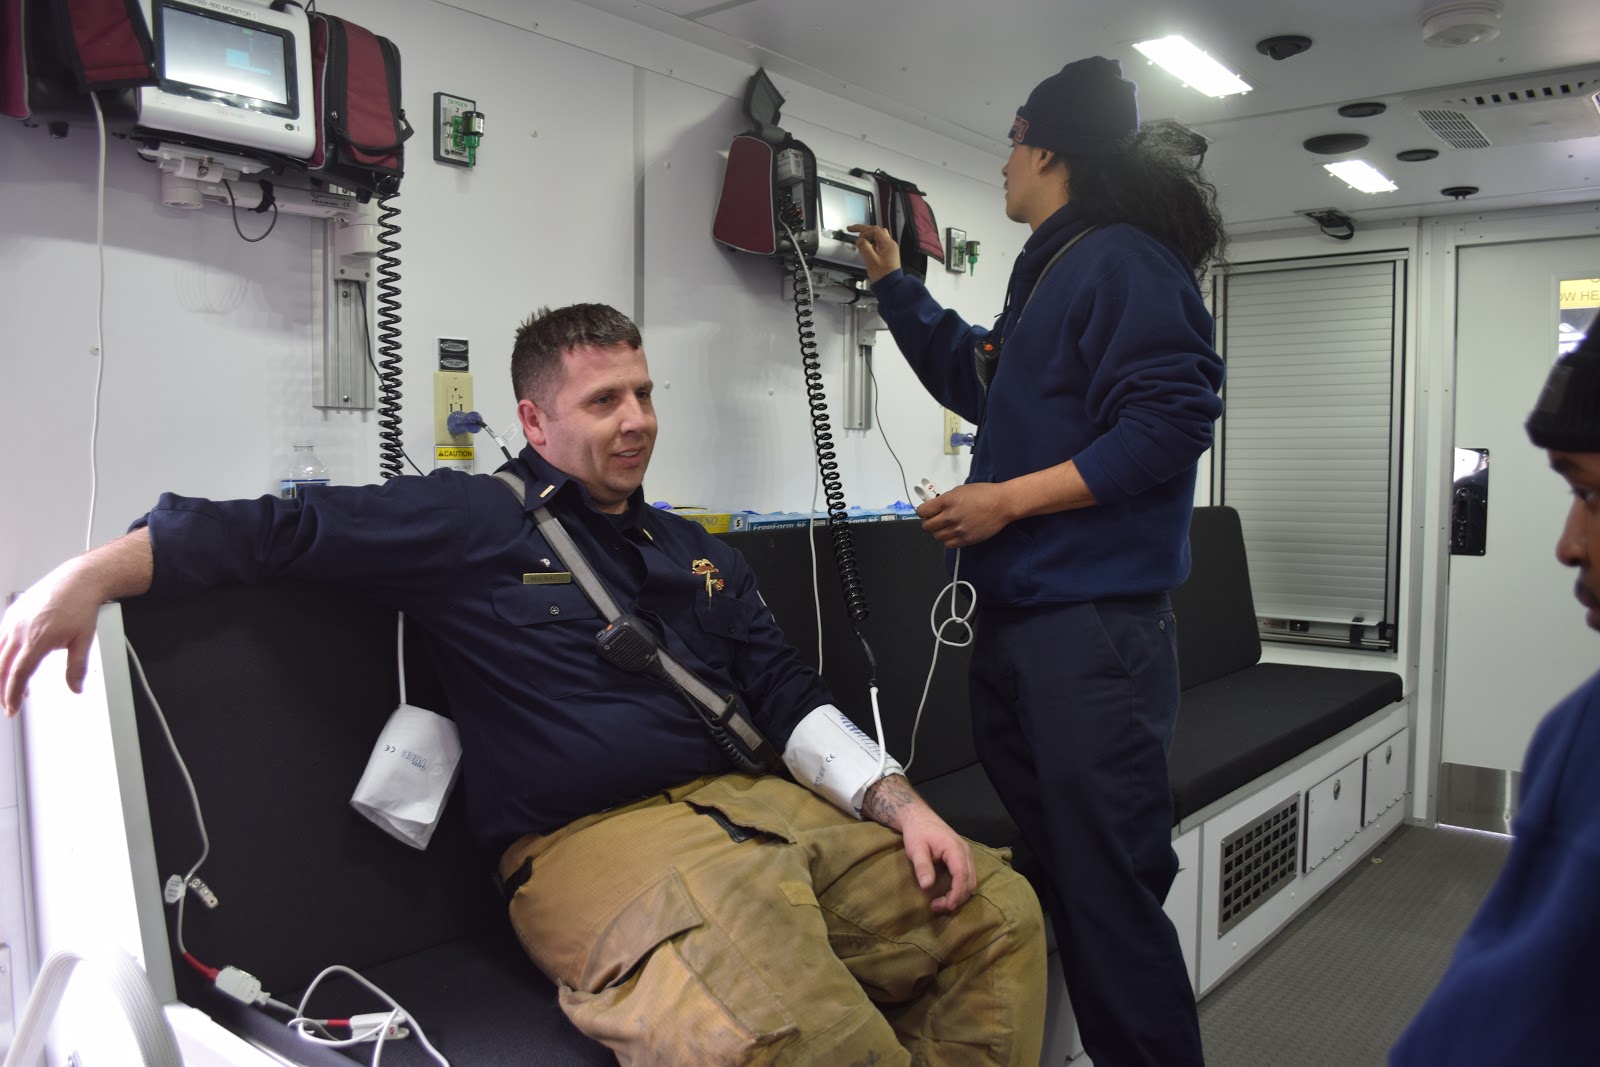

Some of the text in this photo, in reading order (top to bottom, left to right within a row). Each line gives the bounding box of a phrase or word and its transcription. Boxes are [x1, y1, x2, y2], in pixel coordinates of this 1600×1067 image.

[222, 5, 252, 17] MONITOR
[447, 98, 468, 108] OXYGEN
[1580, 290, 1600, 301] HE
